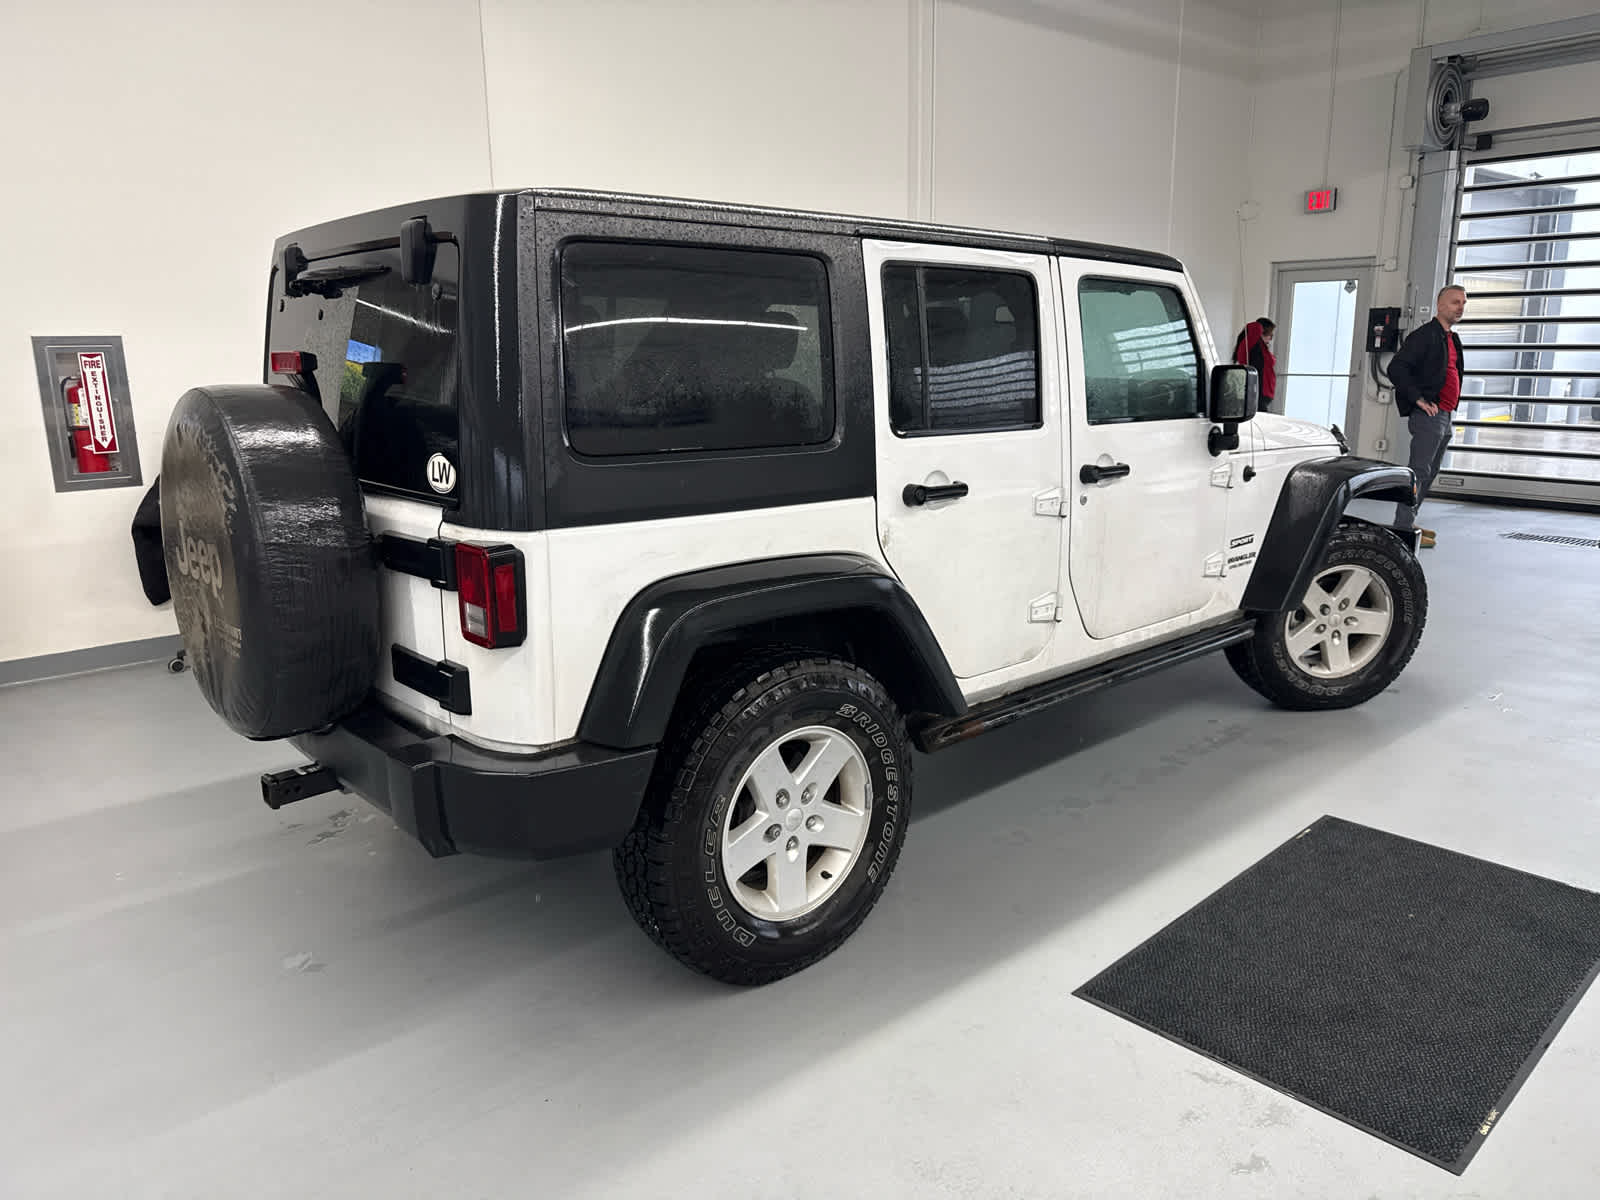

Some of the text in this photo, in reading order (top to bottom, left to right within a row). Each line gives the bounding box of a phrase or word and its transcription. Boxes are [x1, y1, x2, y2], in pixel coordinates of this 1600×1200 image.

[83, 360, 101, 369] FIRE
[90, 370, 108, 442] EXTINGUISHER
[432, 461, 451, 484] LW
[176, 520, 222, 599] Jeep
[1227, 551, 1257, 564] WRANGLER
[835, 703, 899, 884] BRIDGESTONE
[704, 795, 757, 947] DUELER
